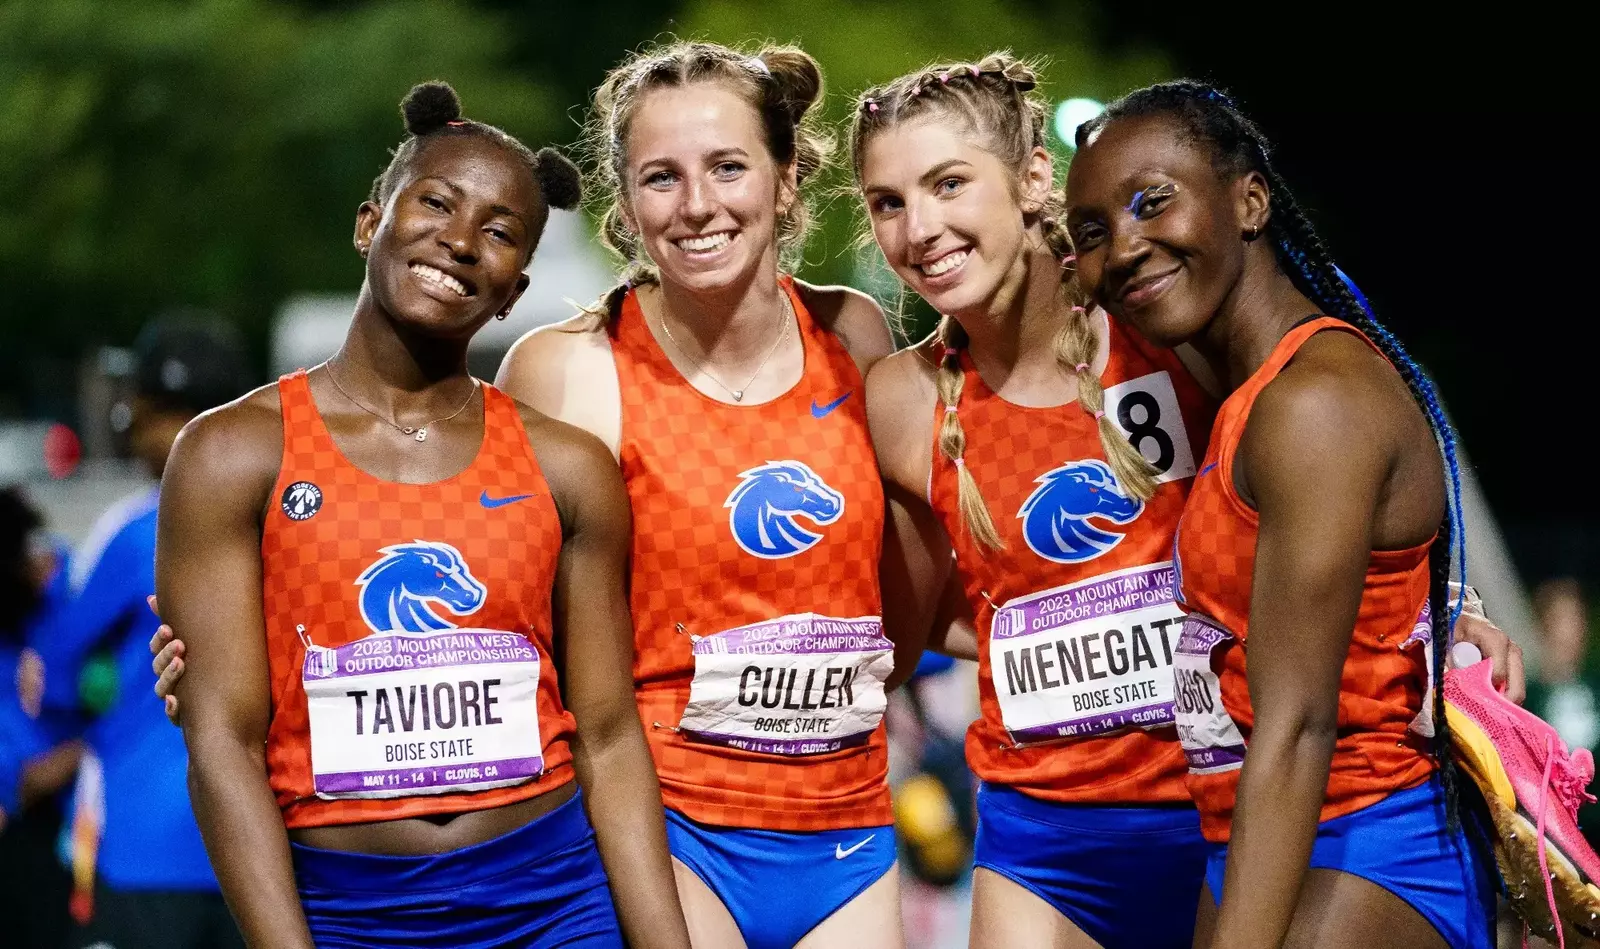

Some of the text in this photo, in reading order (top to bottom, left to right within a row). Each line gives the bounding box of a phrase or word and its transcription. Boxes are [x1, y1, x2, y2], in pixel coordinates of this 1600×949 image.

[1117, 391, 1175, 477] 8
[1038, 594, 1072, 615] 2023
[1074, 574, 1149, 605] MOUNTAIN
[1032, 605, 1091, 630] OUTDOOR
[743, 621, 880, 642] 2023 MOUNTAIN WEST
[352, 634, 519, 657] 2023 MOUNTAIN WEST
[735, 638, 801, 655] OUTDOOR
[1003, 616, 1190, 696] MENEGAT
[345, 647, 533, 673] OUTDOOR CHAMPIONSHIPS
[737, 665, 859, 710] CULLEN
[1072, 680, 1158, 712] BOISE STATE
[346, 678, 503, 735] TAVIORE
[754, 717, 832, 733] BOISE STATE
[1057, 724, 1079, 737] MAY
[1080, 722, 1093, 732] 11
[1101, 718, 1114, 730] 14
[1132, 708, 1170, 724] CLOVIS,
[385, 738, 474, 763] BOISE STATE
[728, 739, 748, 750] MAY
[773, 744, 785, 754] 14
[363, 775, 386, 787] MAY
[388, 774, 400, 785] 11
[411, 772, 425, 783] 14
[445, 767, 483, 780] CLOVIS,
[484, 765, 498, 777] CA
